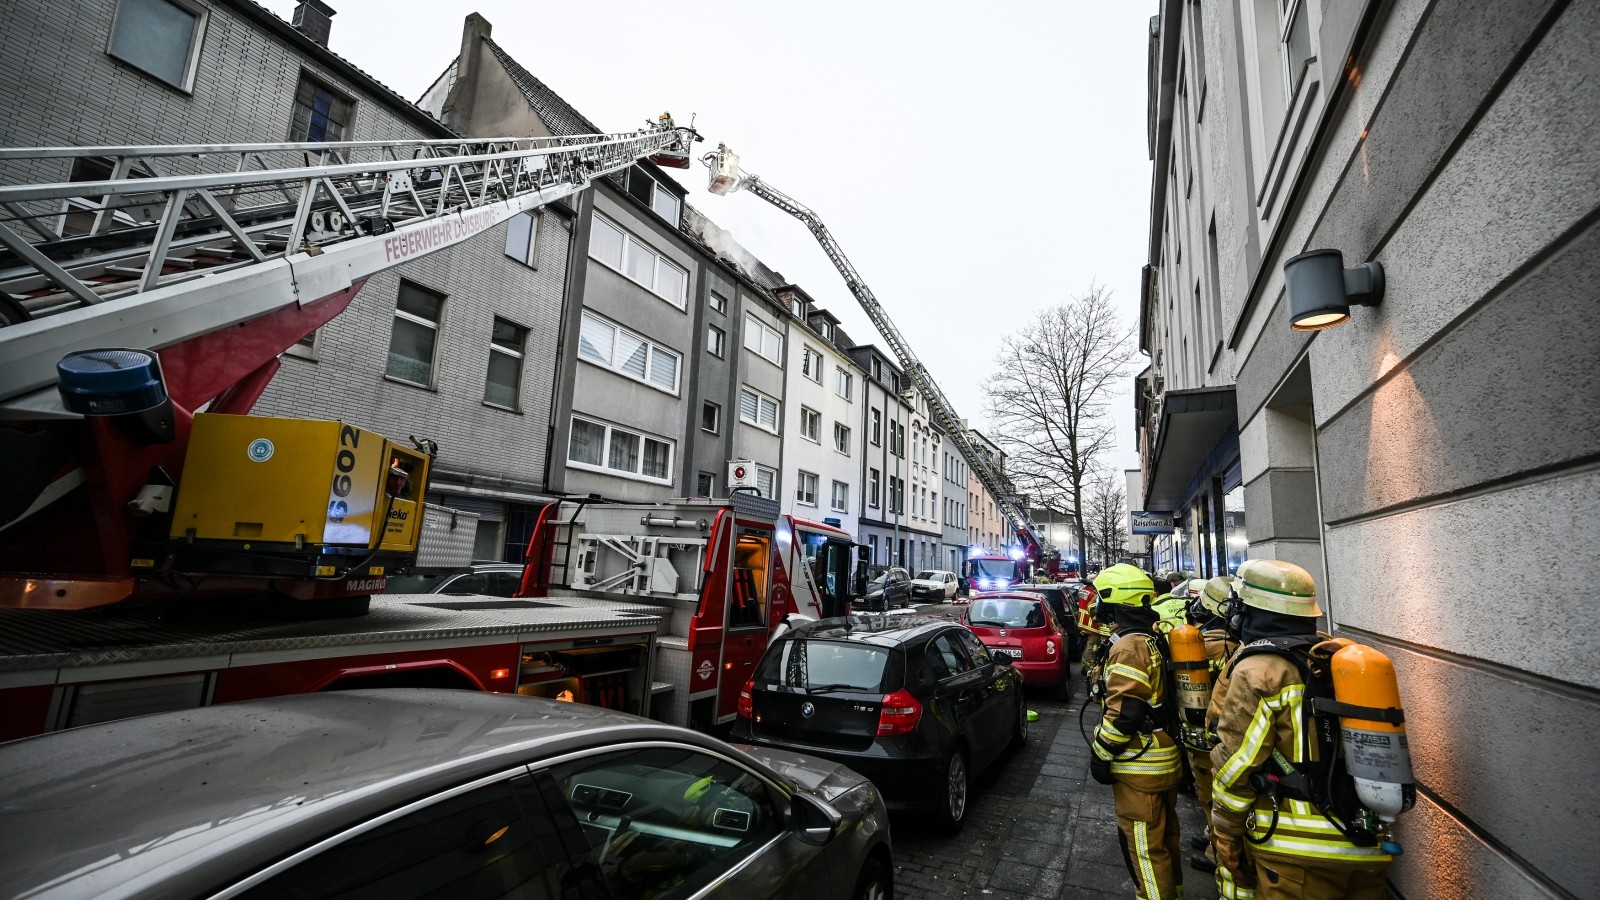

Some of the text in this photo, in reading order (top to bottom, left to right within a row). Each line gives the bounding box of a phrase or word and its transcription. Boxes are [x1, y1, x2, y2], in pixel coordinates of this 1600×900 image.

[385, 210, 496, 262] FEUERWEHR DUISBURG
[328, 425, 360, 523] 6602
[1184, 683, 1207, 691] MSA
[1362, 735, 1391, 745] MSA
